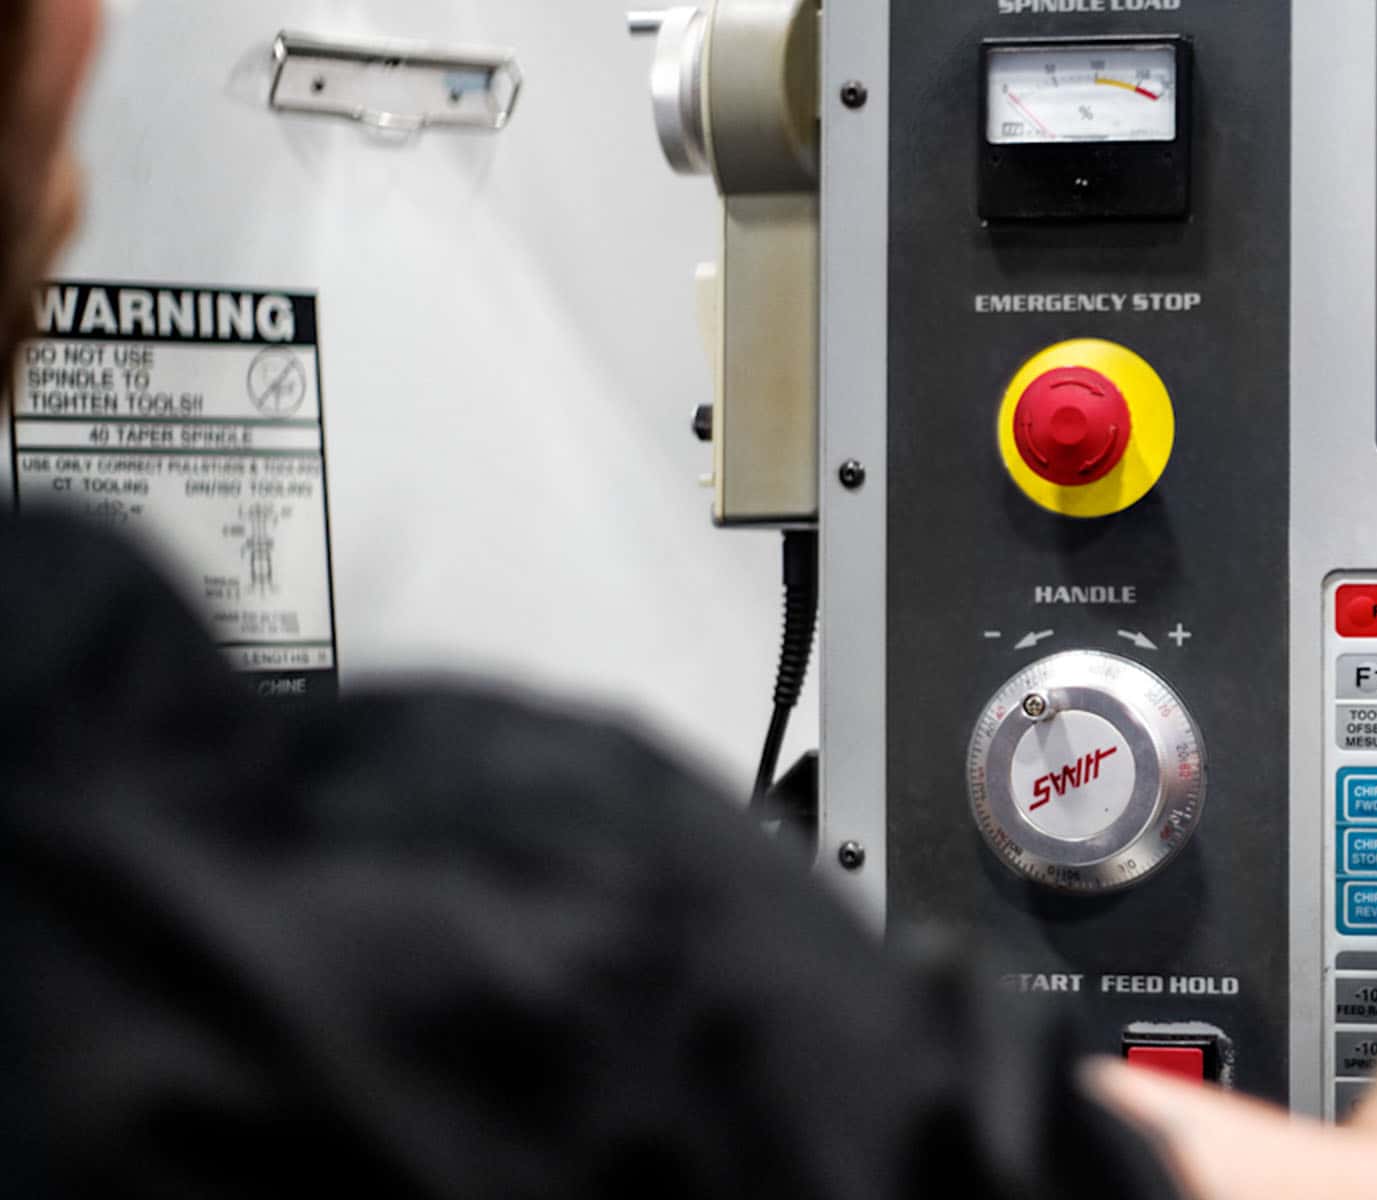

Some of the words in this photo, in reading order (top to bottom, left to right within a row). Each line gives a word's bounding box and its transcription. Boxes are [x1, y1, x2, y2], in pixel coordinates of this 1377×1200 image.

[998, 0, 1105, 13] SPINDLE
[1111, 0, 1181, 11] LOAD
[974, 294, 1127, 312] EMERGENCY
[1132, 293, 1201, 311] STOP
[33, 286, 297, 341] WARNING
[26, 345, 57, 366] DO
[64, 346, 105, 367] NOT
[114, 347, 154, 367] USE
[28, 368, 114, 390] SPINDLE
[122, 370, 150, 391] TO
[30, 391, 118, 412] TIGHTEN
[89, 429, 109, 443] 40
[117, 429, 173, 443] TAPER
[181, 429, 253, 444] SPINDLE
[53, 478, 73, 492] CT
[83, 479, 149, 494] TOOLING
[1034, 586, 1137, 604] HANDLE
[1101, 976, 1163, 994] FEED
[1170, 977, 1239, 995] HOLD
[1336, 1005, 1364, 1016] FEED
